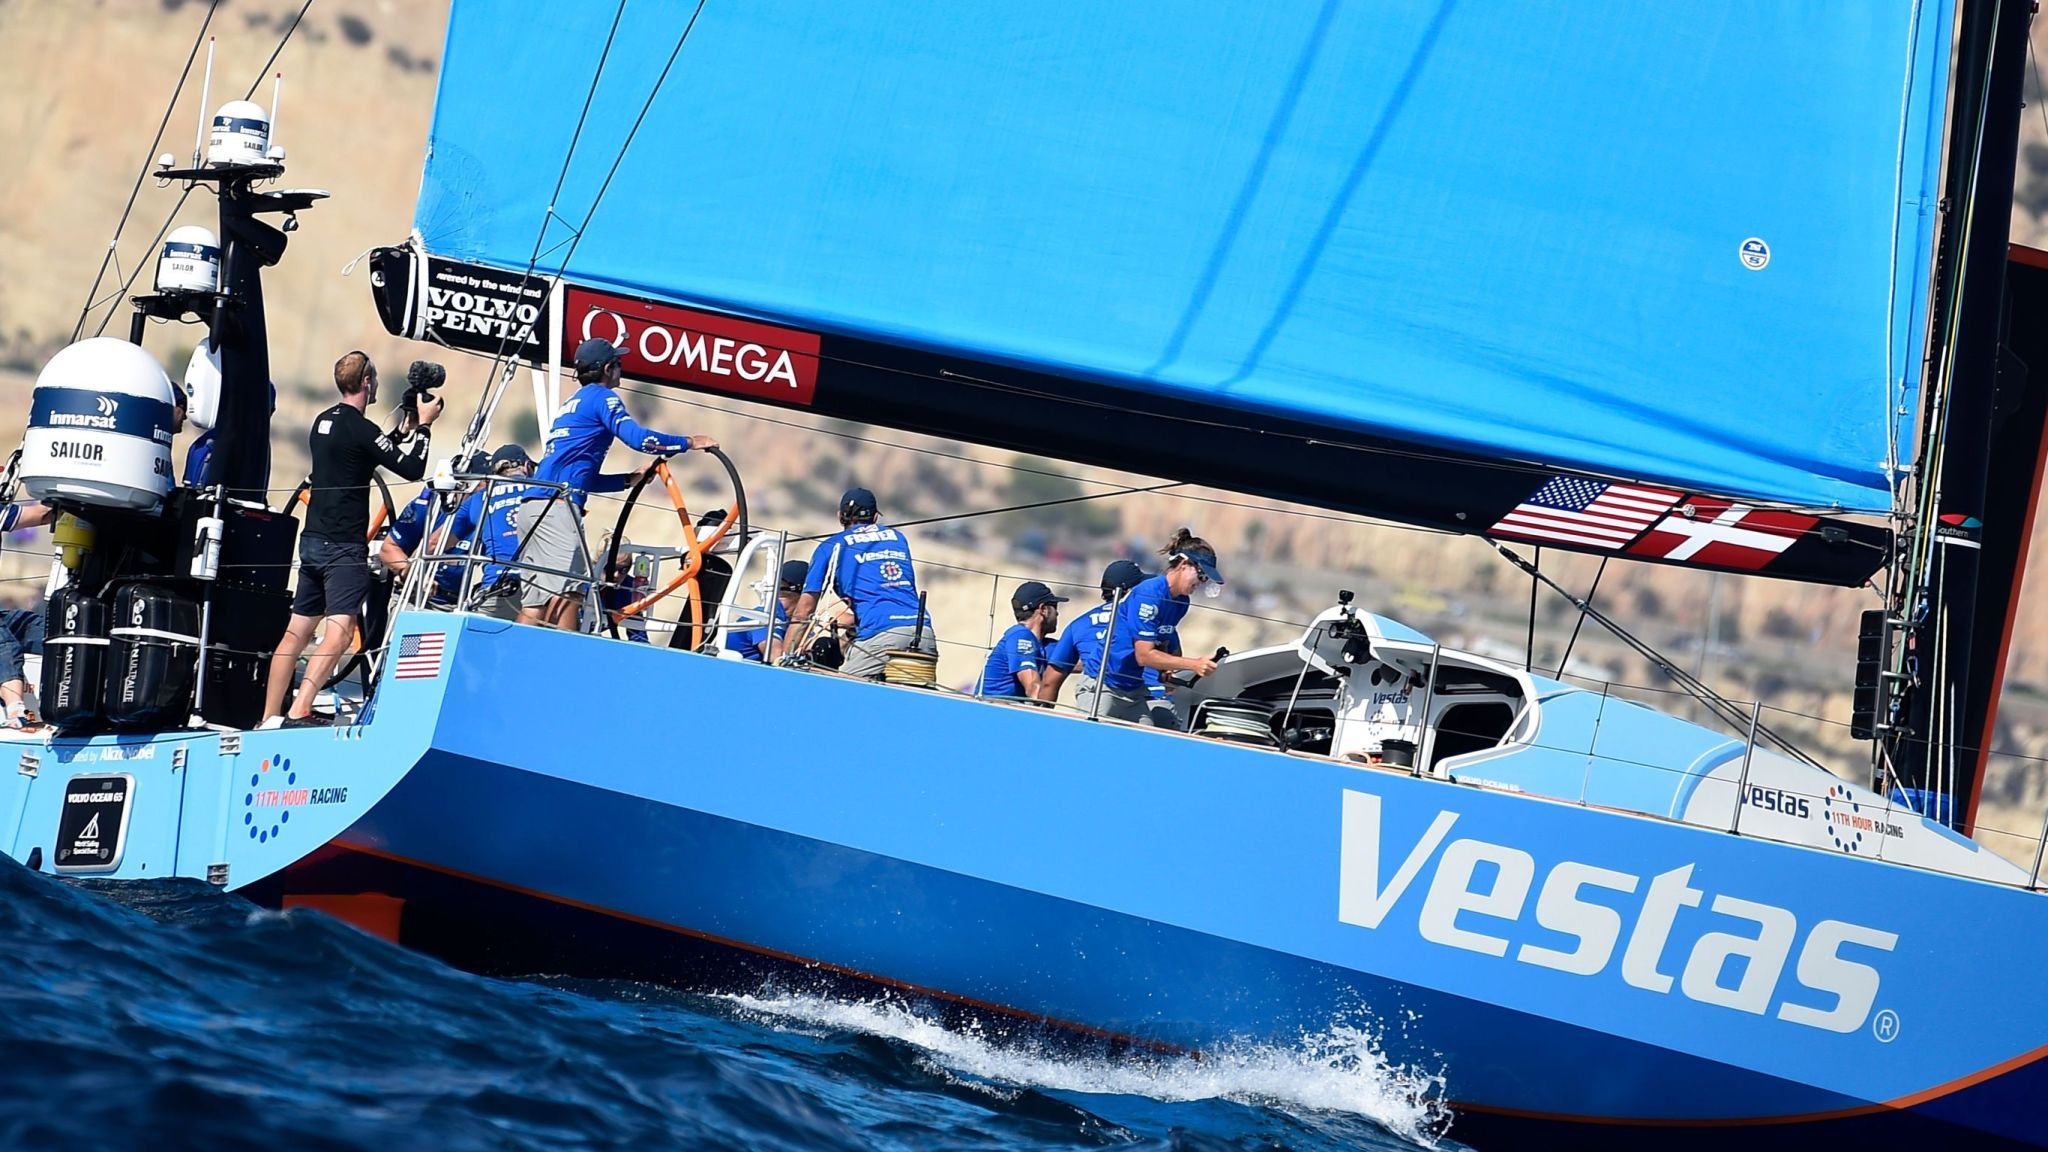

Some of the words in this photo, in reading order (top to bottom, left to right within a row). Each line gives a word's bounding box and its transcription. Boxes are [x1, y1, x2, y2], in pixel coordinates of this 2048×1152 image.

[170, 249, 202, 260] inmarsat
[172, 263, 194, 271] SAILOR
[469, 277, 480, 288] by
[482, 280, 498, 290] the
[499, 284, 522, 294] wind
[428, 287, 539, 323] VOLVO
[427, 307, 540, 345] PENTA
[639, 326, 798, 388] OMEGA
[50, 410, 116, 429] inmarsat
[153, 424, 172, 443] inma
[50, 441, 104, 462] SAILOR
[489, 496, 523, 514] Vest
[854, 549, 906, 564] Vestas
[58, 663, 73, 708] ULTRALITE
[123, 658, 141, 703] ULTRALITE
[1373, 690, 1408, 704] Vestas
[68, 793, 90, 803] VOLVO
[90, 793, 113, 802] OCEAN
[113, 792, 123, 802] 65
[256, 791, 279, 806] 11TH
[281, 789, 308, 805] HOUR
[310, 787, 348, 804] RACING
[1832, 811, 1851, 825] 11TH
[1852, 815, 1873, 831] HOUR
[1875, 820, 1903, 838] RACING
[1339, 788, 1899, 1034] Vestas
